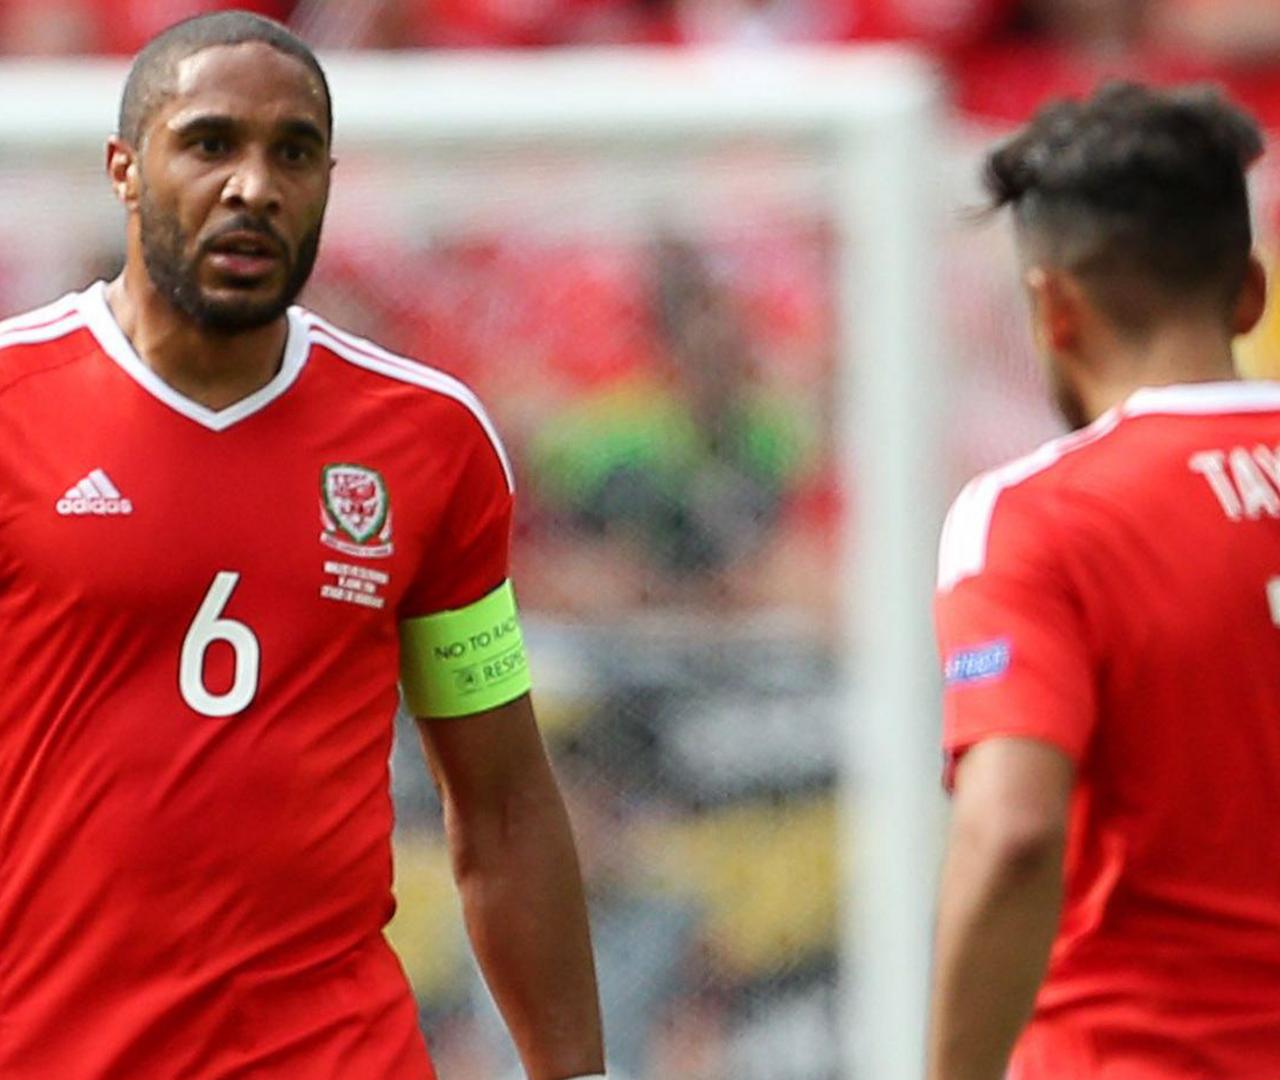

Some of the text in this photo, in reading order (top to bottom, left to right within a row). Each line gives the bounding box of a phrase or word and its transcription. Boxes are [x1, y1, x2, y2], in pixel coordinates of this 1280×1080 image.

[179, 571, 259, 718] 6
[433, 641, 466, 660] NO
[468, 632, 492, 651] TO
